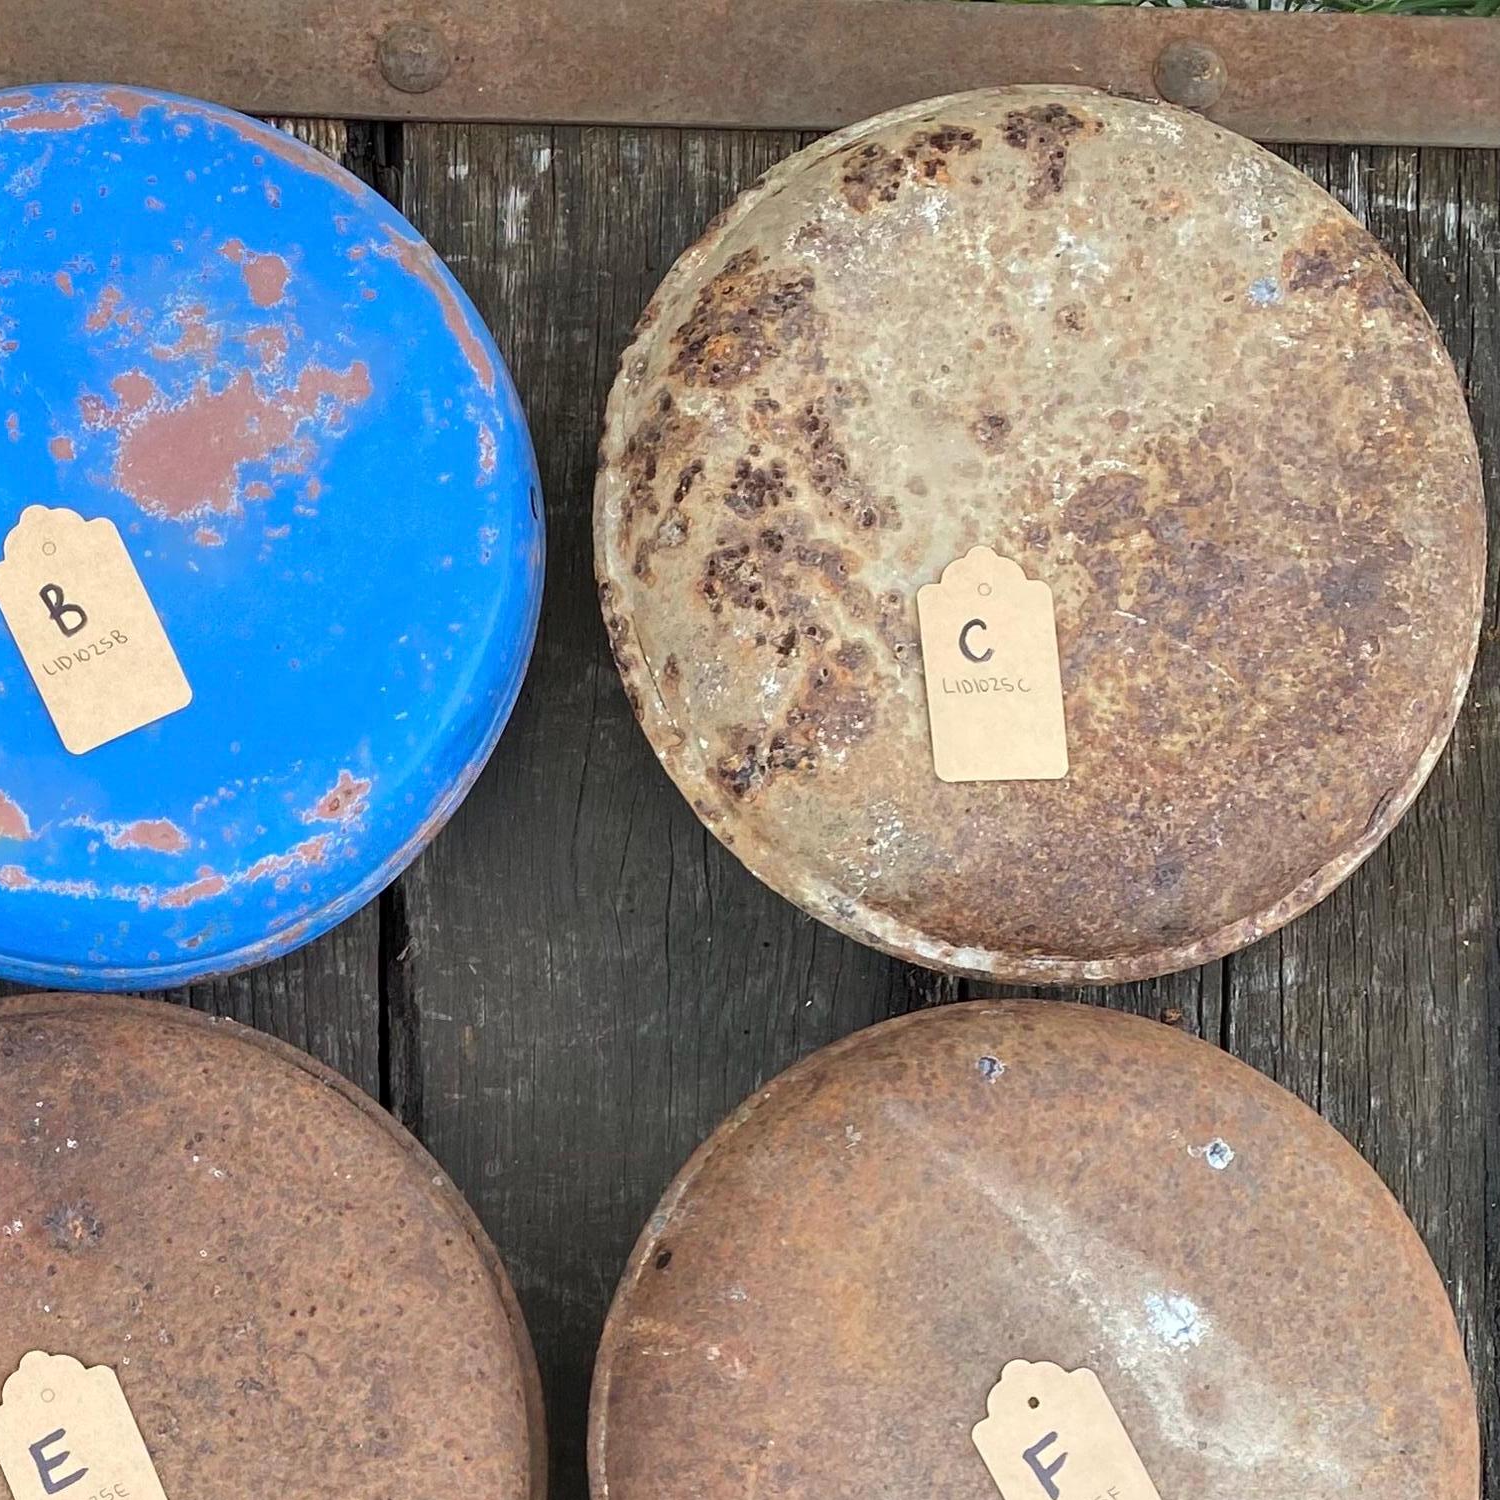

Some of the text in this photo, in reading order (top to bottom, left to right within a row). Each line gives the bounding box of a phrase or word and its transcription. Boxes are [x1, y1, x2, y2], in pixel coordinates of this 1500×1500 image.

[38, 583, 88, 638] B
[41, 629, 129, 676] LID1025B
[958, 618, 995, 664] C
[28, 1427, 90, 1495] E
